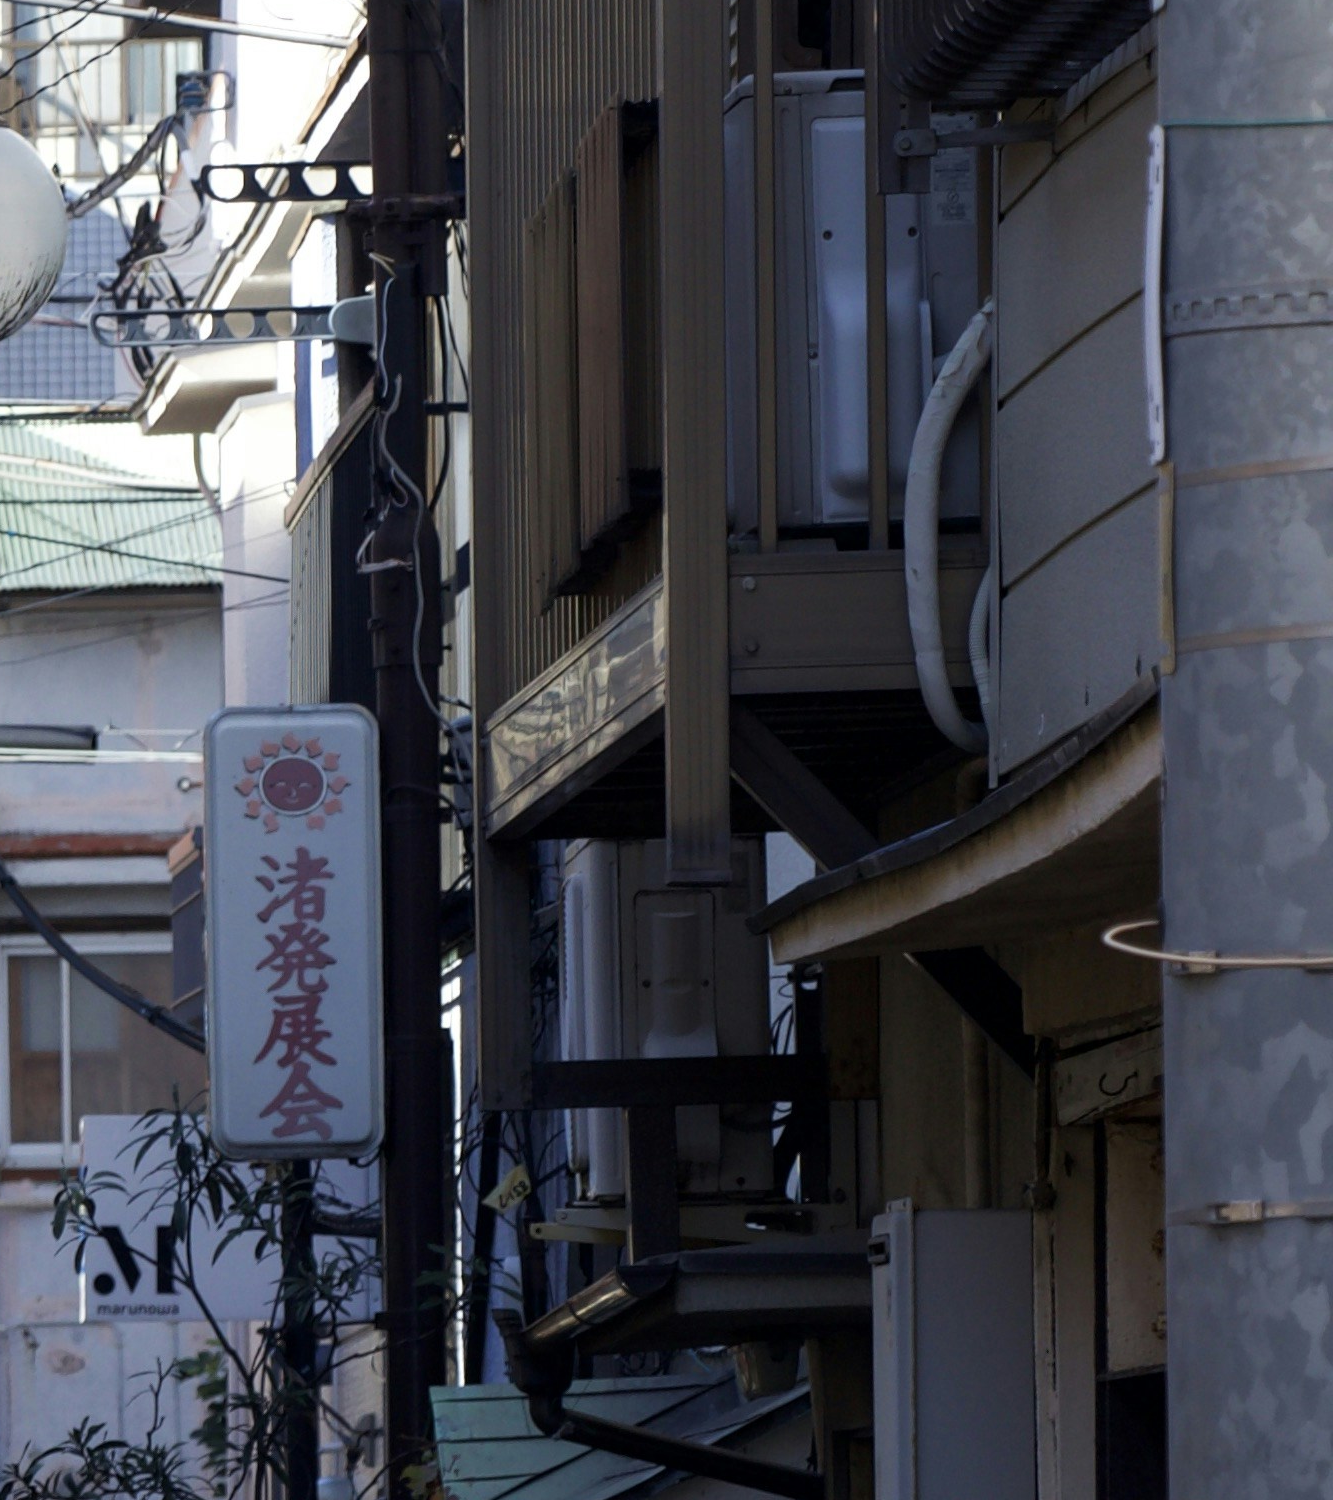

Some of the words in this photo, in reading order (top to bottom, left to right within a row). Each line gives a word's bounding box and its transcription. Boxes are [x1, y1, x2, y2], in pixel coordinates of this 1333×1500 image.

[254, 846, 343, 1141] 渚発展会
[97, 1304, 180, 1316] marunowa
